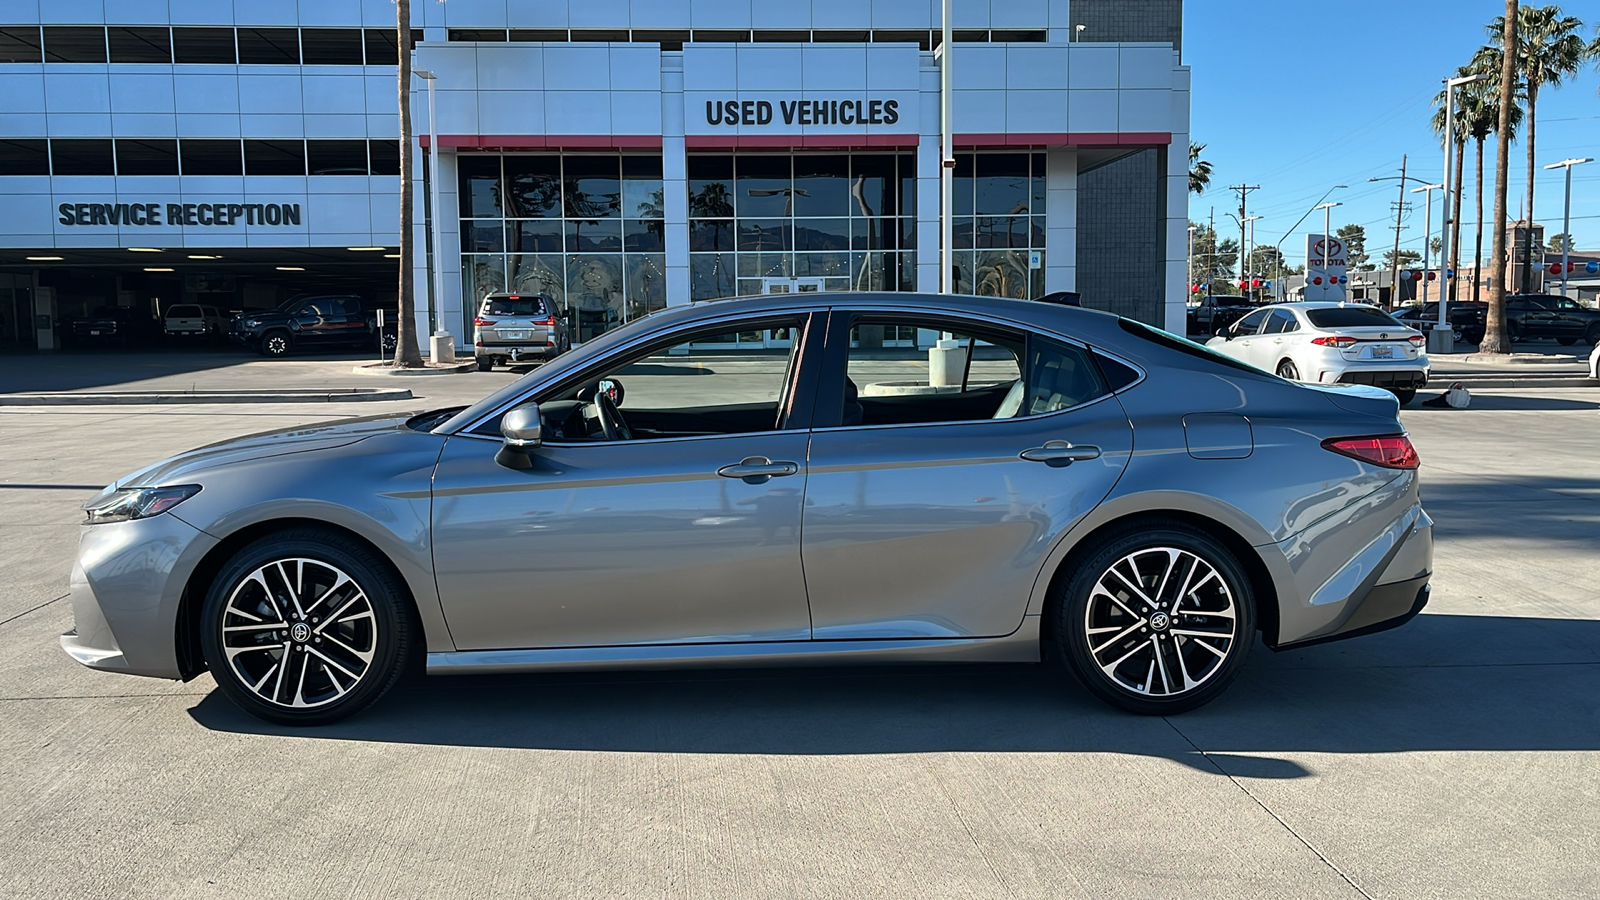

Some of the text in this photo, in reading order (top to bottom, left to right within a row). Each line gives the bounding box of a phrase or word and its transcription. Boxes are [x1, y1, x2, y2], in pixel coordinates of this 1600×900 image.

[706, 100, 899, 125] USED VEHICLES
[58, 203, 301, 226] SERVICE RECEPTION
